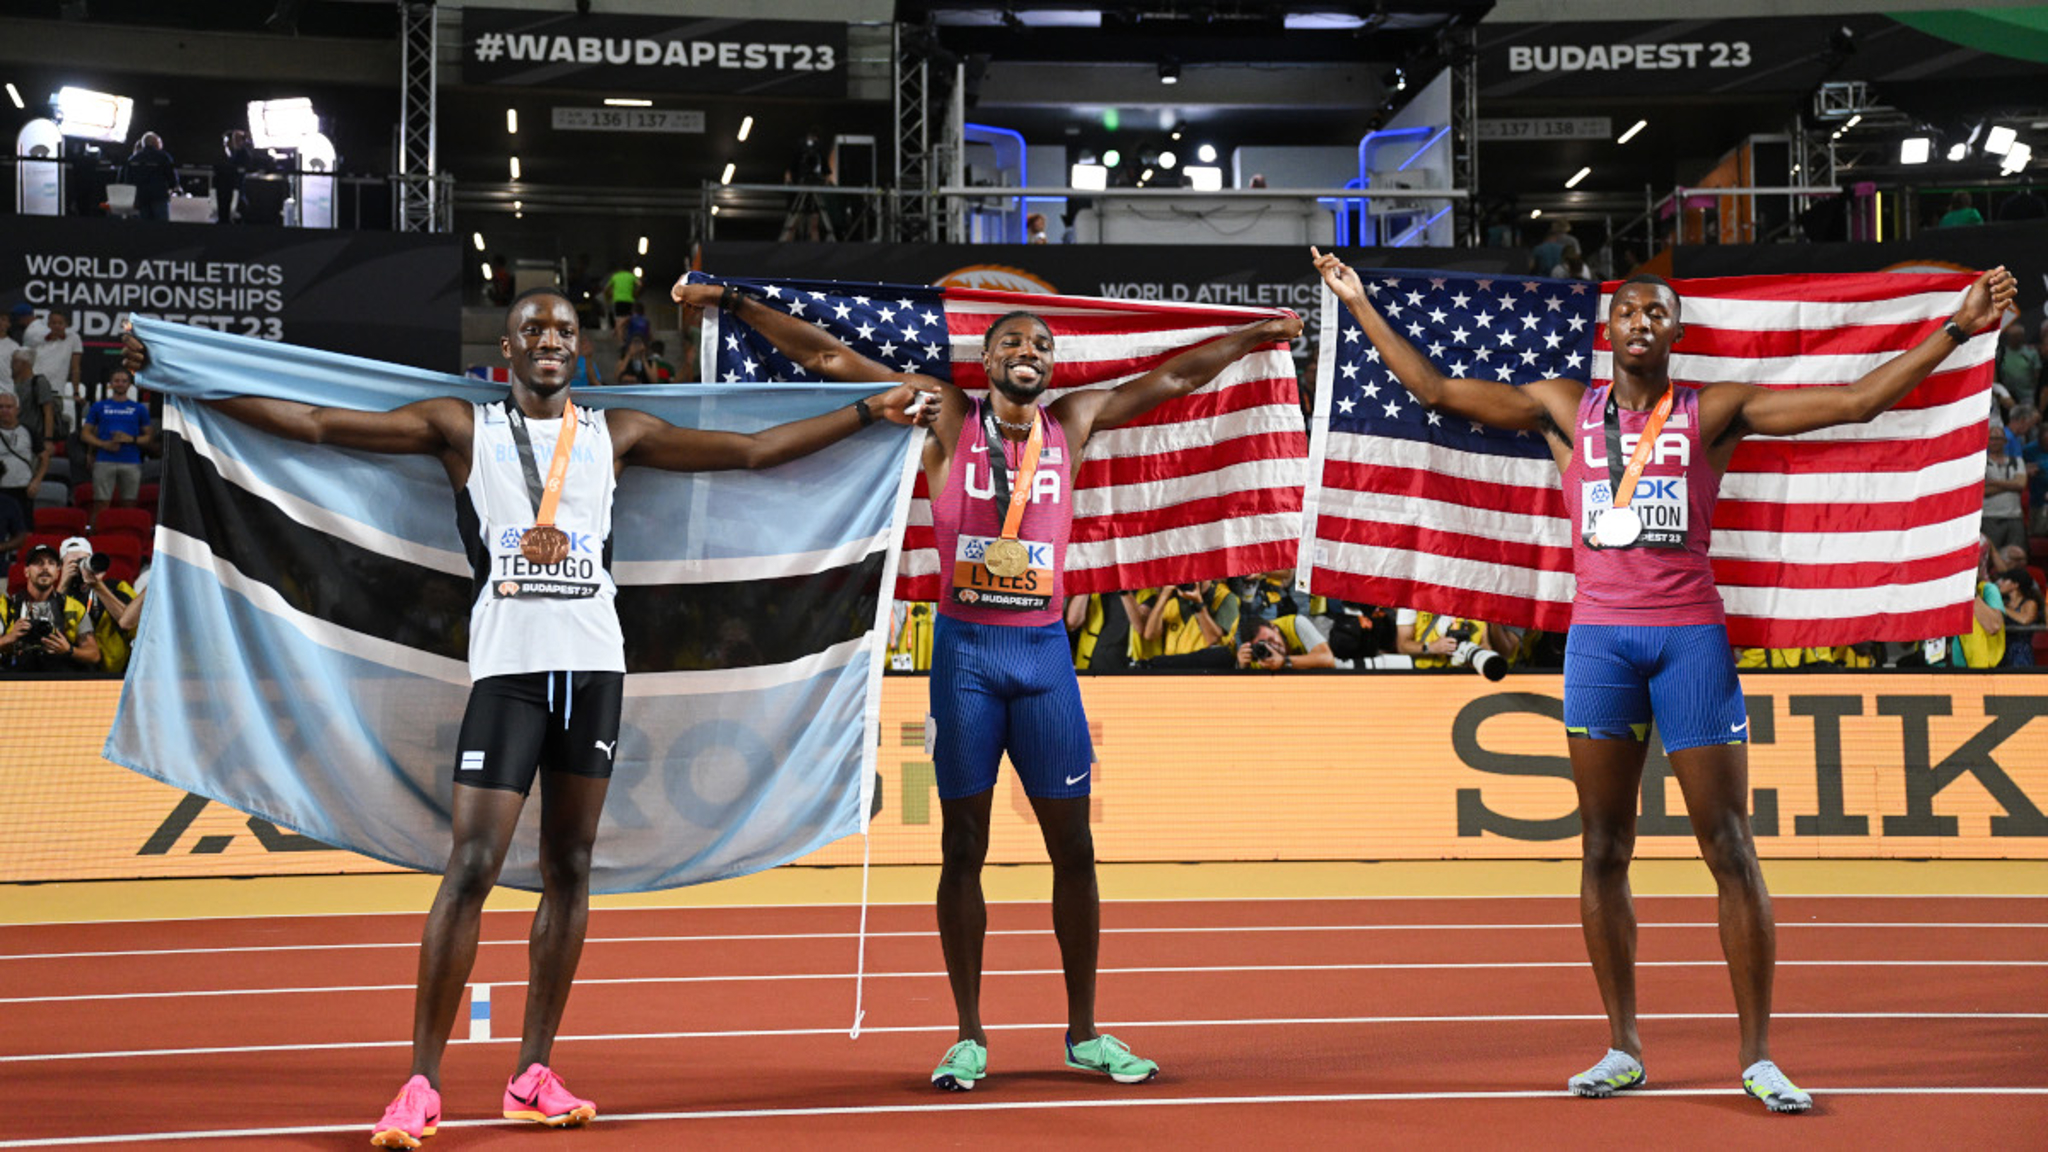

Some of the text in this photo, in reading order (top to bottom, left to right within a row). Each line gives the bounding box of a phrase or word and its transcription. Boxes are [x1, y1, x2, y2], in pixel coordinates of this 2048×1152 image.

[475, 32, 836, 71] #WABUDAPEST23
[1509, 41, 1752, 72] BUDAPEST 23
[591, 111, 622, 127] 136
[637, 113, 668, 128] 137
[25, 253, 284, 286] WORLD ATHLETICS
[24, 279, 284, 312] CHAMPIONSHIPS
[1100, 282, 1322, 304] WORLD ATHLETICS
[241, 317, 284, 341] 23
[495, 443, 595, 463] BOSWNA
